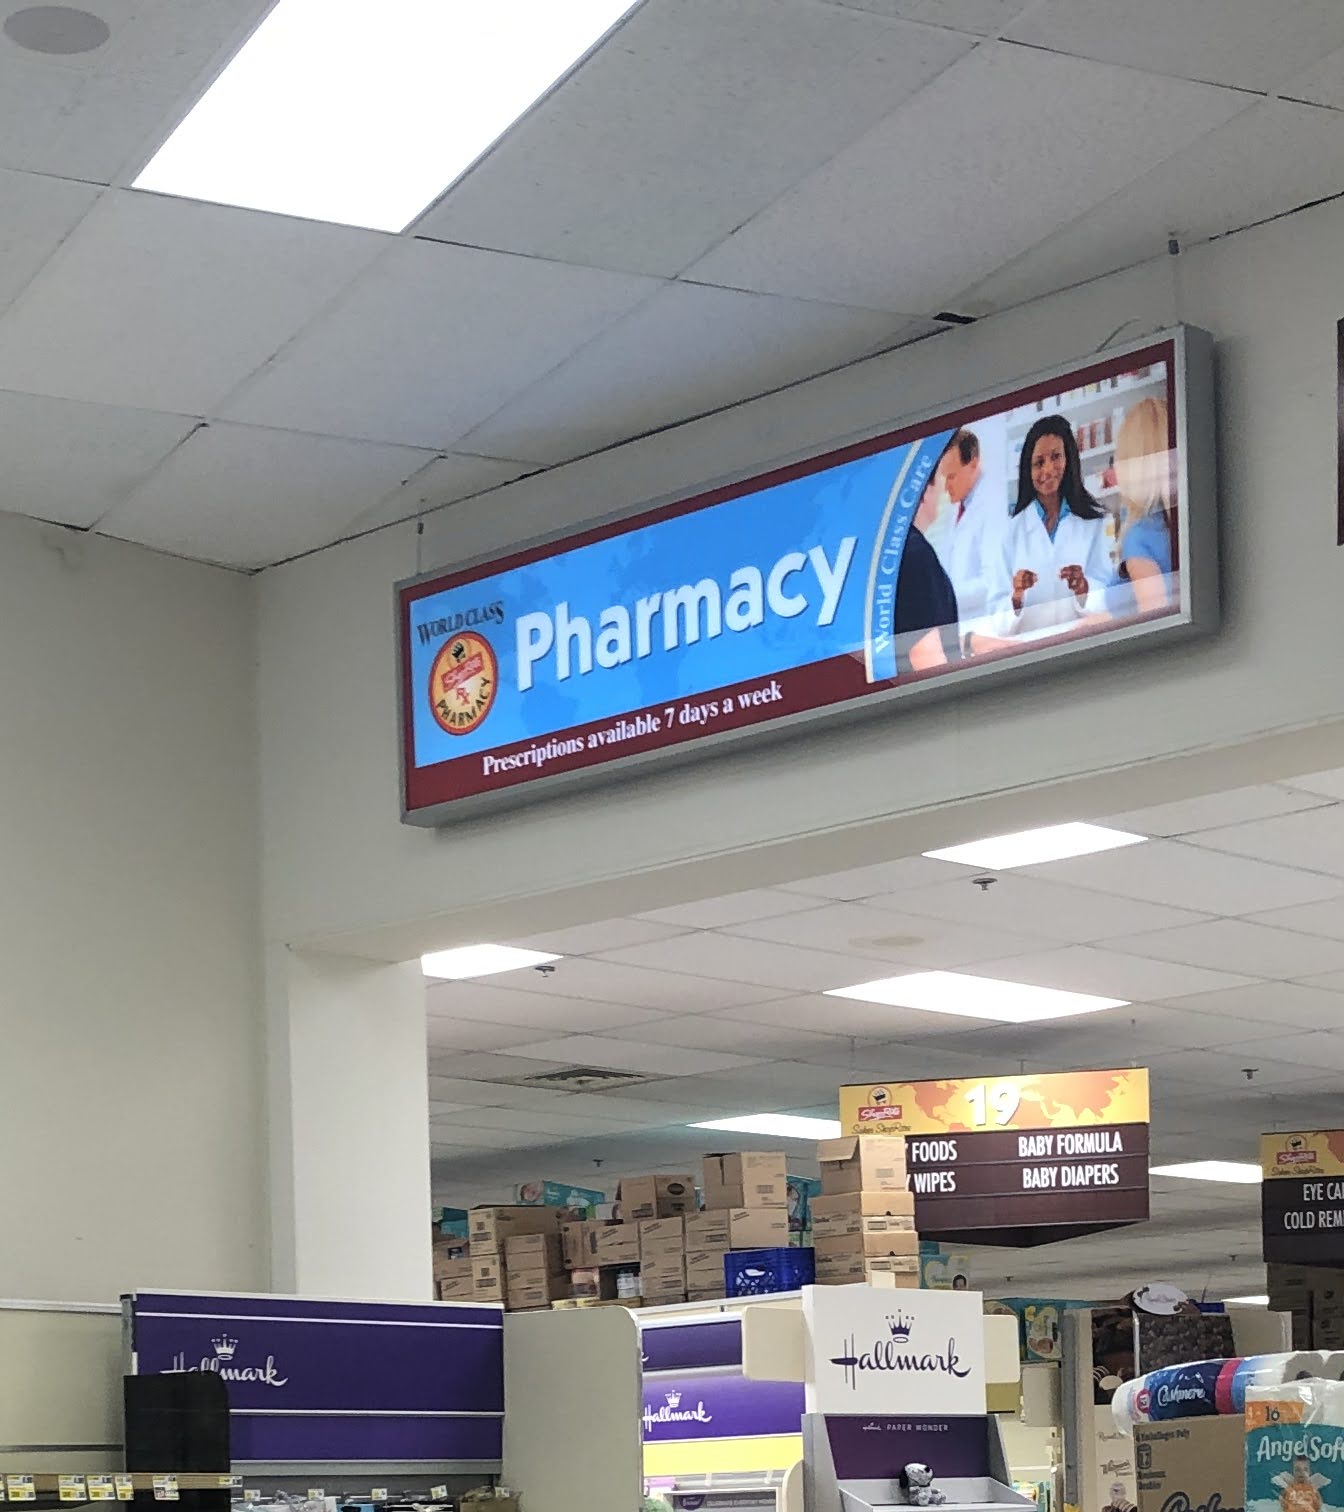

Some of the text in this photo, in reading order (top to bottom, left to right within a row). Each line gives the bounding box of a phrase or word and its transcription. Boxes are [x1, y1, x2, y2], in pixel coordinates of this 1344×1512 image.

[875, 455, 933, 653] World Class Care
[516, 535, 857, 692] Pharmacy
[437, 676, 490, 725] PHARMACY
[482, 681, 783, 775] Prescriptions available 7 days a week
[965, 1081, 1022, 1127] 19
[912, 1139, 957, 1162] FOODS
[1018, 1131, 1123, 1157] BABY FORMULA
[914, 1171, 956, 1193] WIPES
[1022, 1164, 1119, 1188] BABY DIAPERS
[1303, 1183, 1323, 1201] EYE
[1284, 1211, 1315, 1230] COLD
[828, 1333, 971, 1390] Hallmark
[643, 1402, 711, 1432] Hallmark
[886, 1423, 912, 1431] PAPER
[916, 1424, 948, 1432] WONDER
